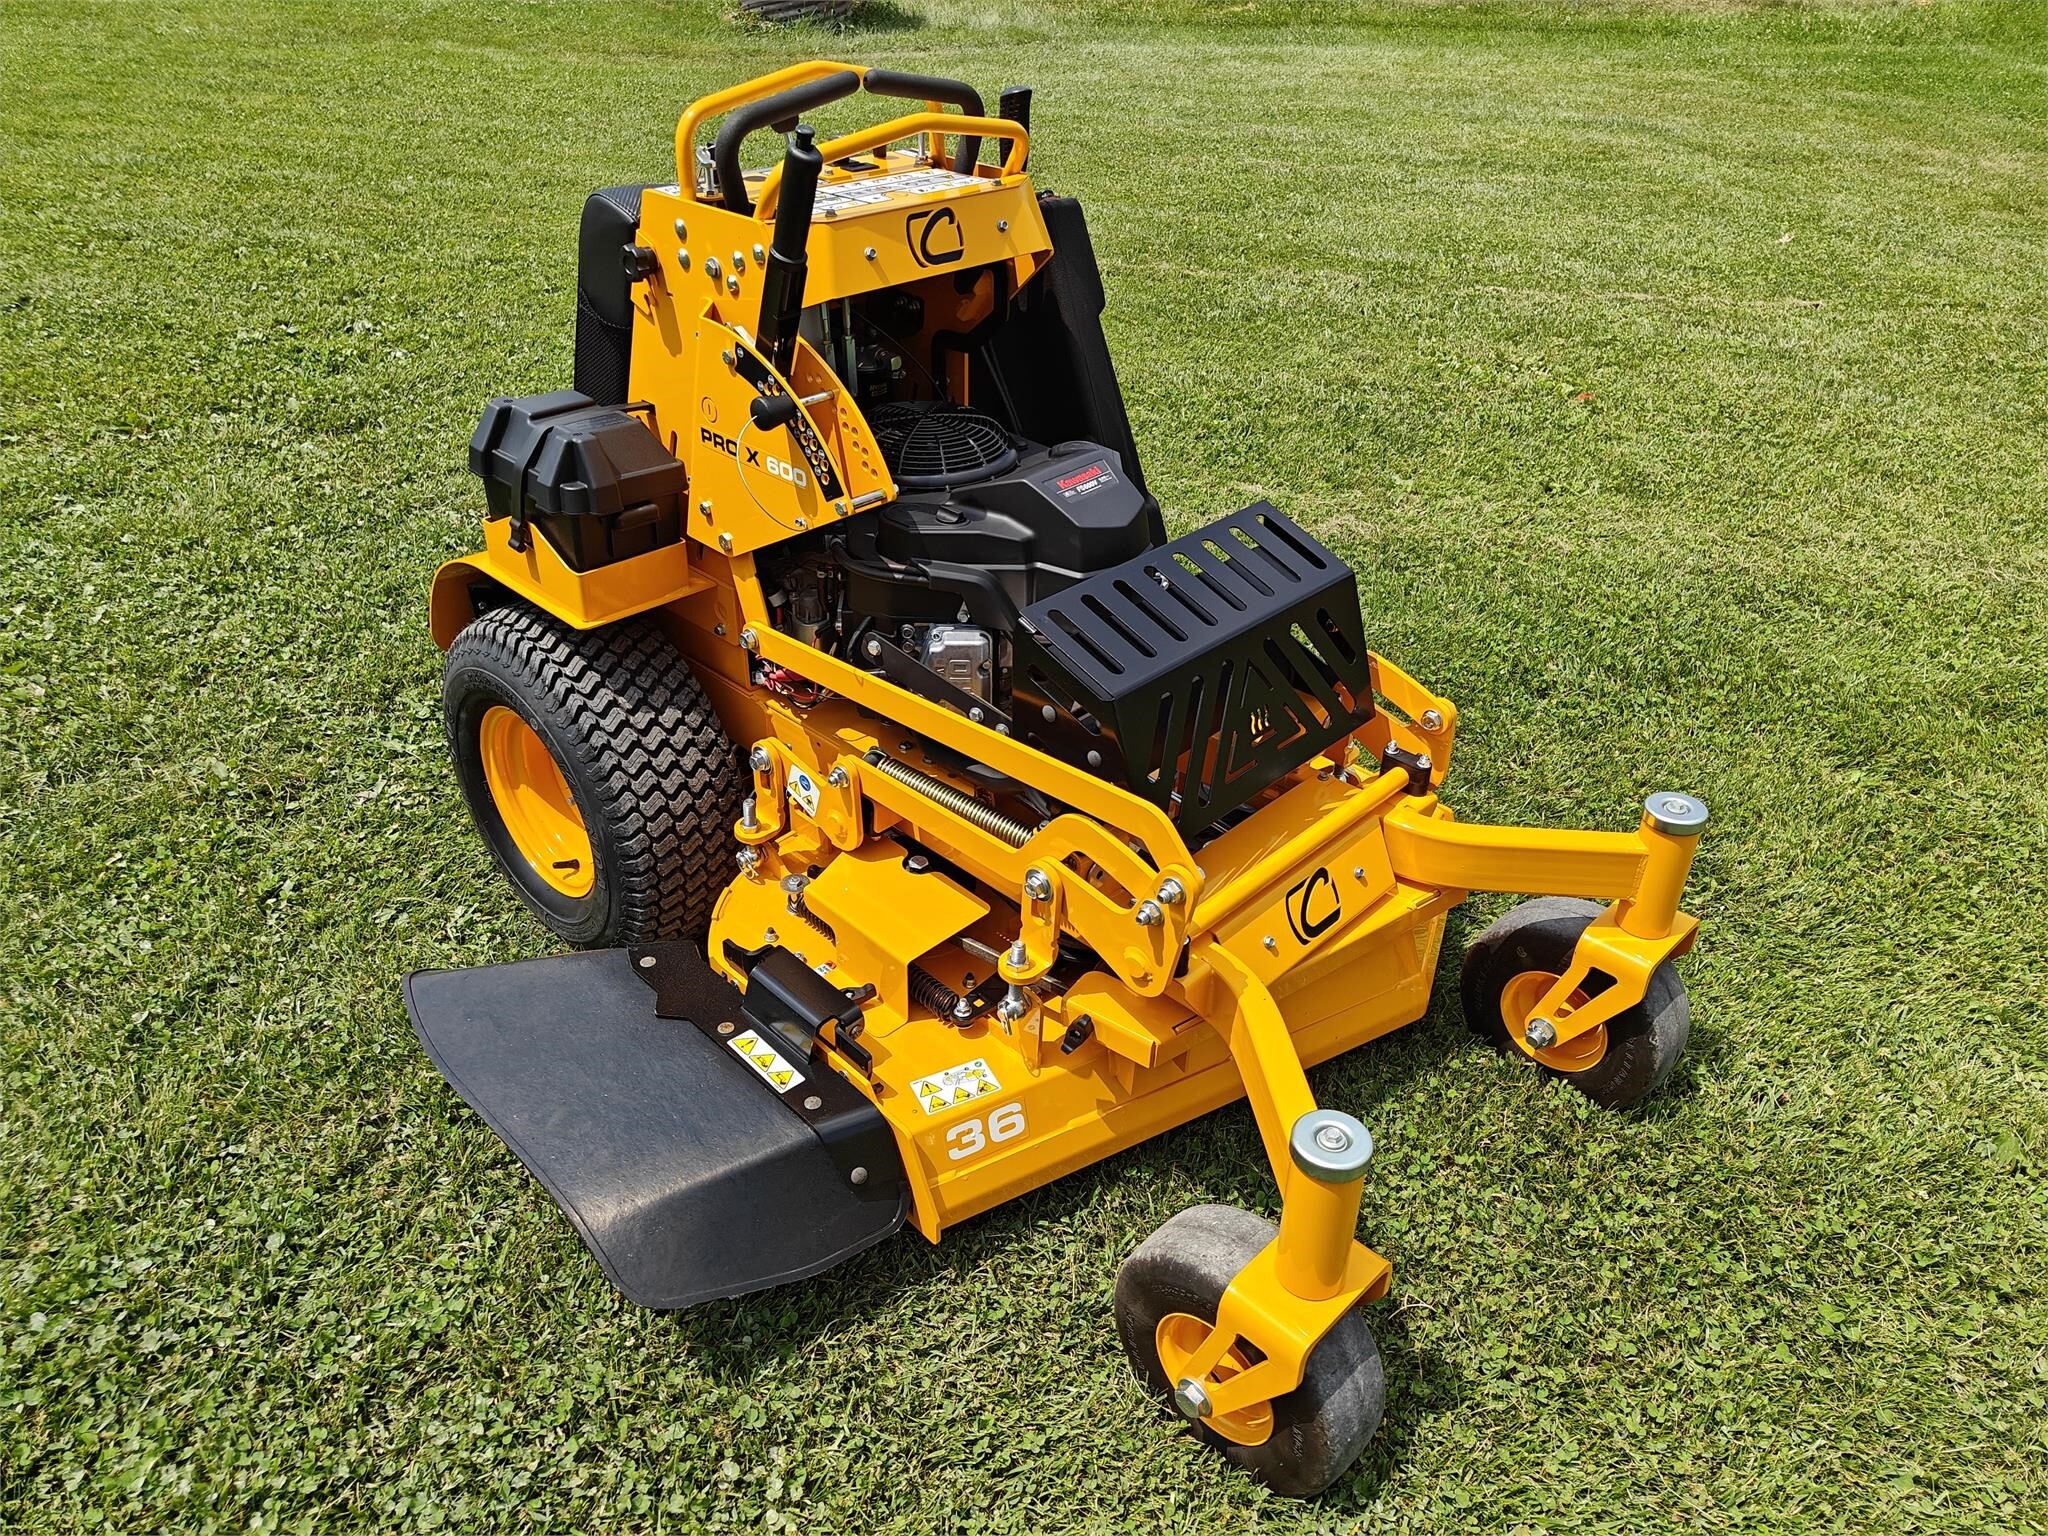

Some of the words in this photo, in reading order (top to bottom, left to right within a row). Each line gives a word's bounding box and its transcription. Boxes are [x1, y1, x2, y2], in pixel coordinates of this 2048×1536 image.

[701, 427, 737, 457] PRO
[745, 446, 760, 467] X
[766, 456, 807, 488] 600
[1056, 466, 1102, 489] Kawasaki
[945, 1101, 1027, 1161] 36
